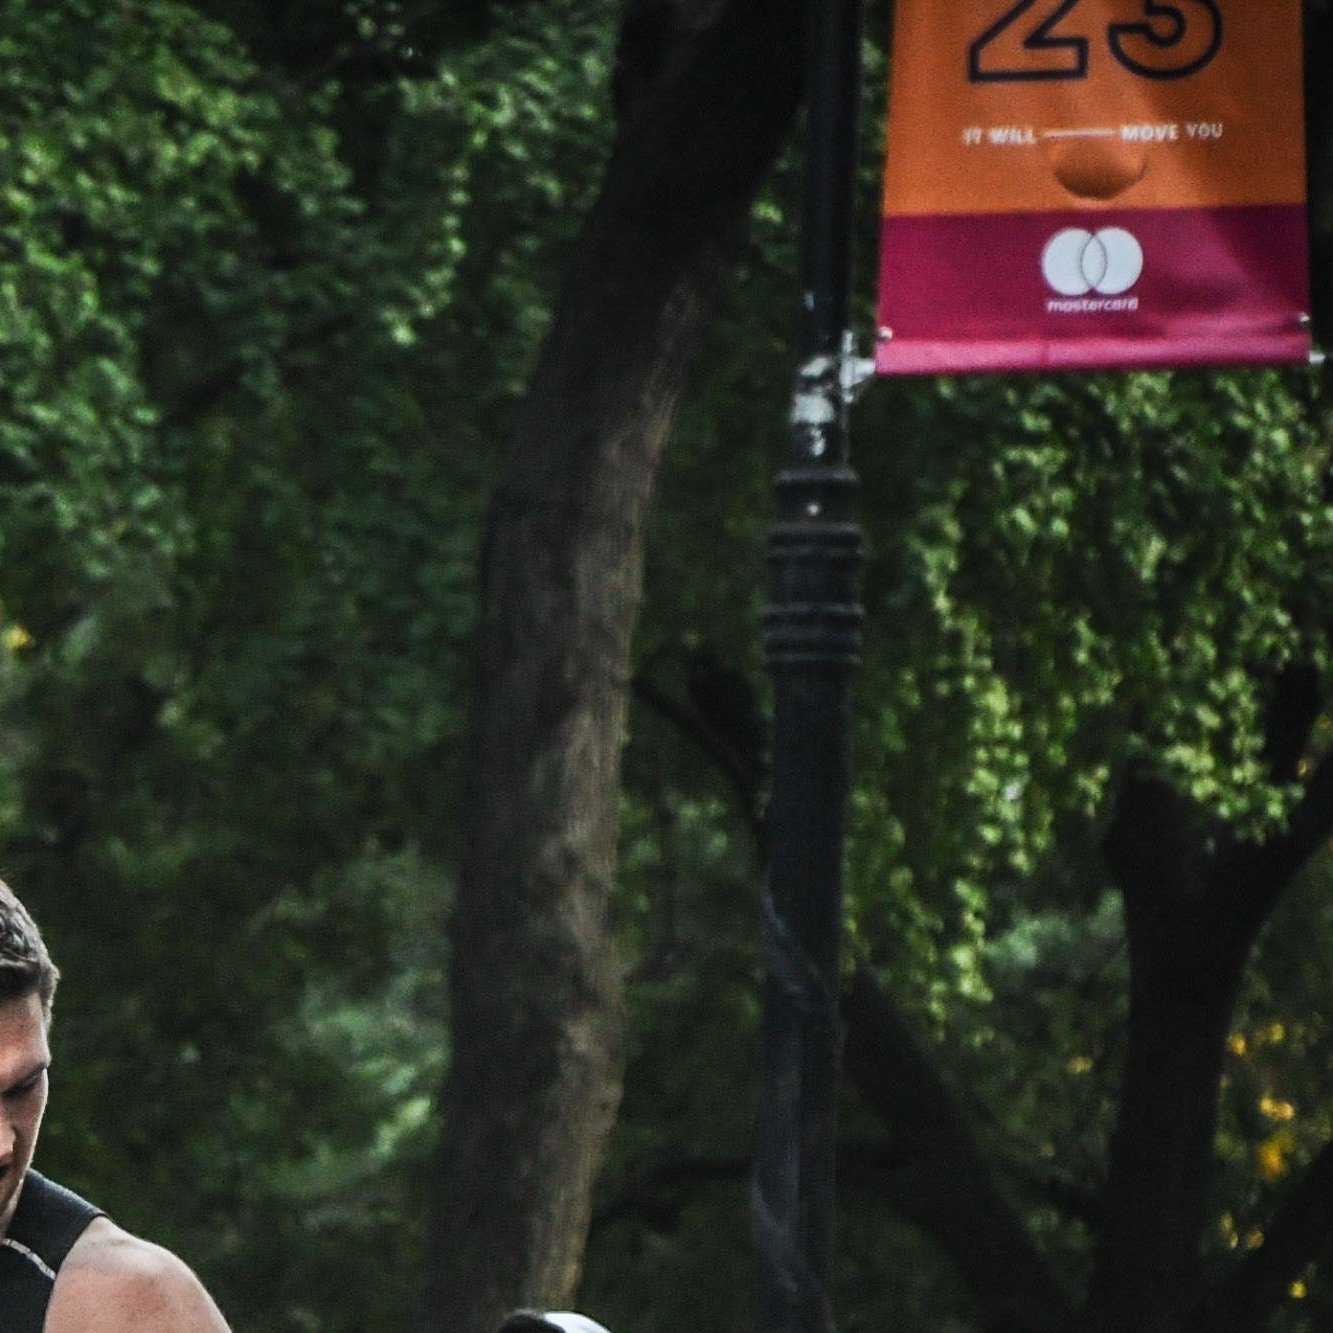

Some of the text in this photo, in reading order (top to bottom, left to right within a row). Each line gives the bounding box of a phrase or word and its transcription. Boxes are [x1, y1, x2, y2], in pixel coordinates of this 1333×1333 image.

[988, 127, 1035, 145] WILL
[1120, 124, 1178, 141] MOVE
[1186, 123, 1223, 139] YOU
